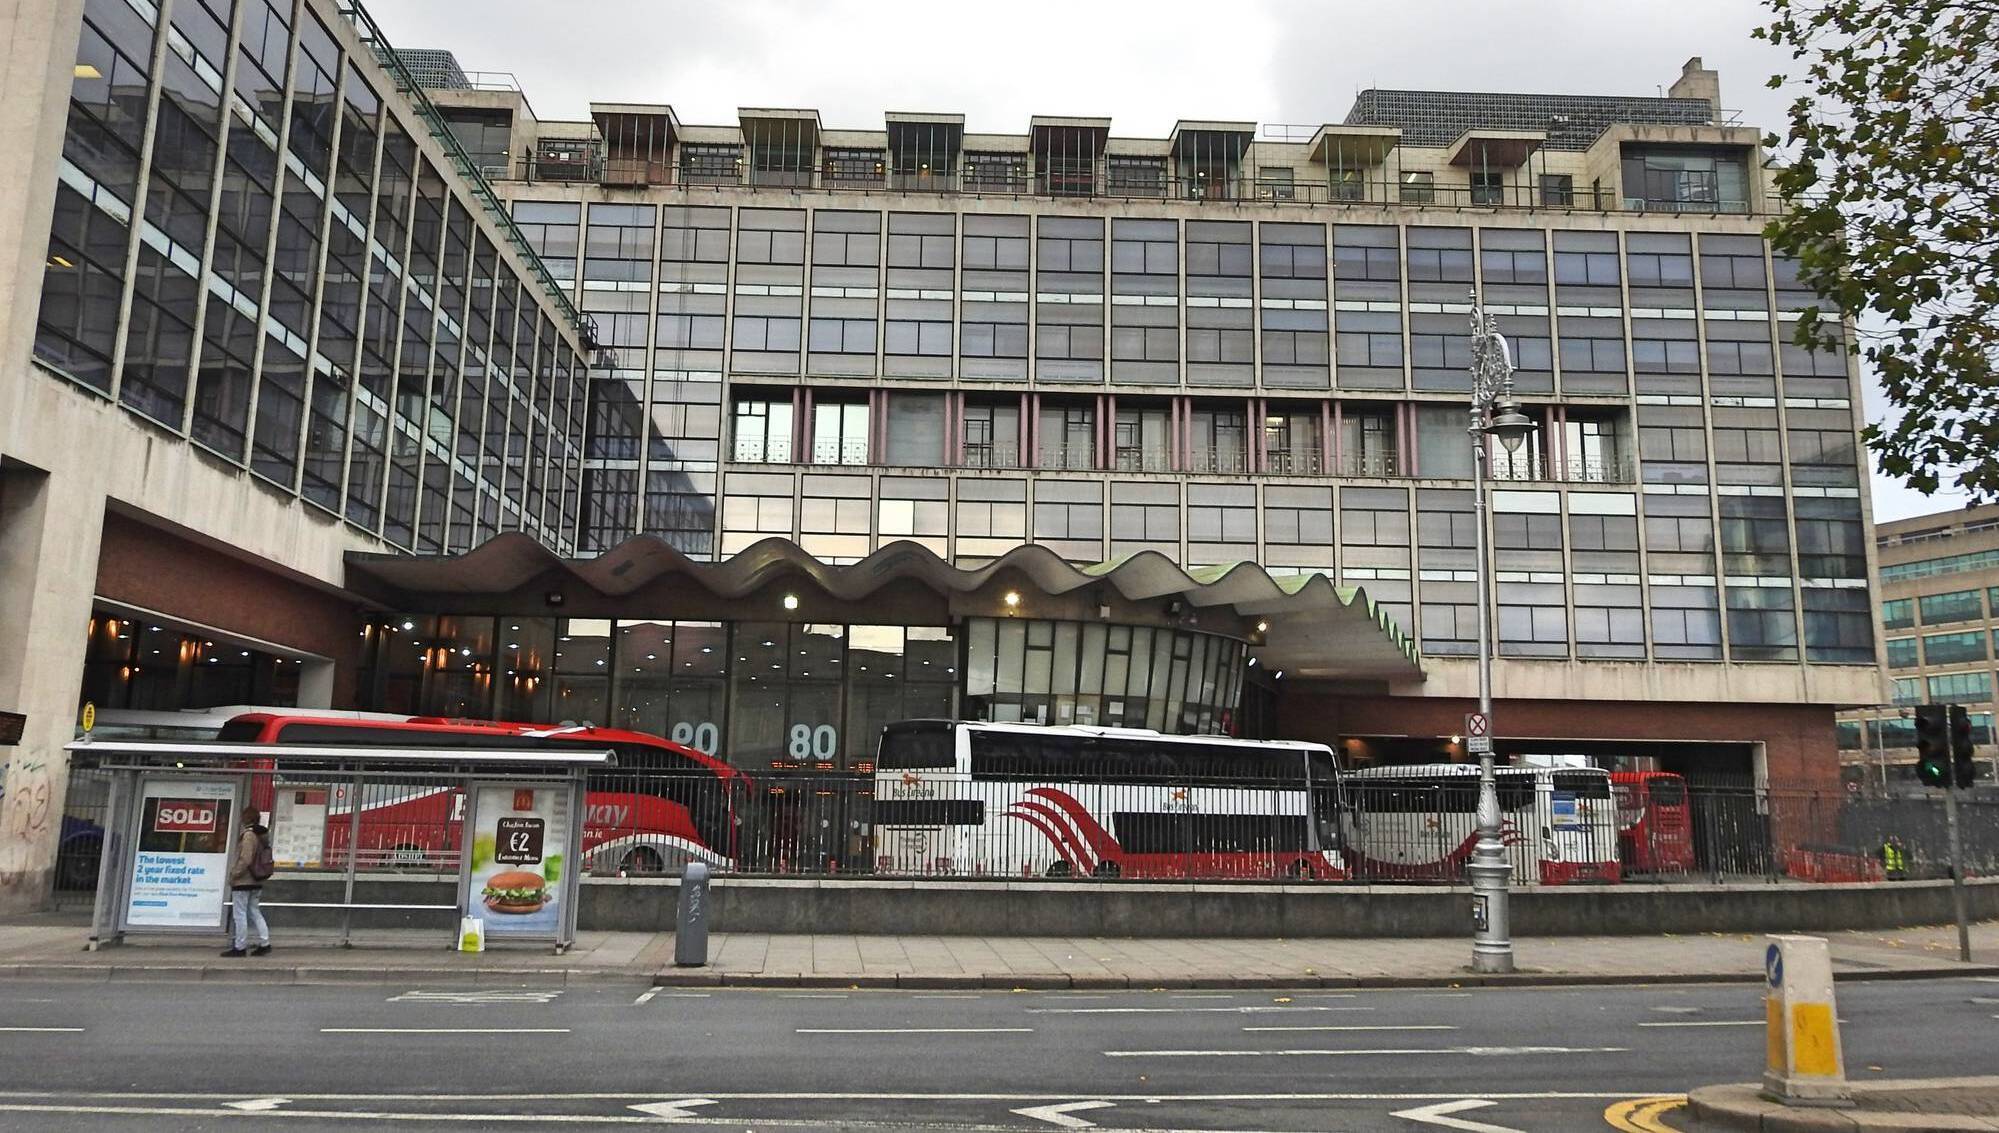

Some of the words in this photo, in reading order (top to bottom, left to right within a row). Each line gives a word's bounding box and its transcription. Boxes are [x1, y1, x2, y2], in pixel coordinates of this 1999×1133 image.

[672, 722, 719, 757] 90
[789, 724, 837, 760] 80
[159, 808, 214, 825] SOLD
[509, 832, 530, 852] €2
[139, 855, 154, 864] The
[156, 856, 186, 865] lowest
[136, 865, 144, 874] 2
[144, 866, 163, 875] year
[164, 865, 187, 874] fixed
[187, 867, 205, 875] rate
[136, 875, 144, 883] in
[145, 875, 160, 884] the
[160, 876, 192, 884] market
